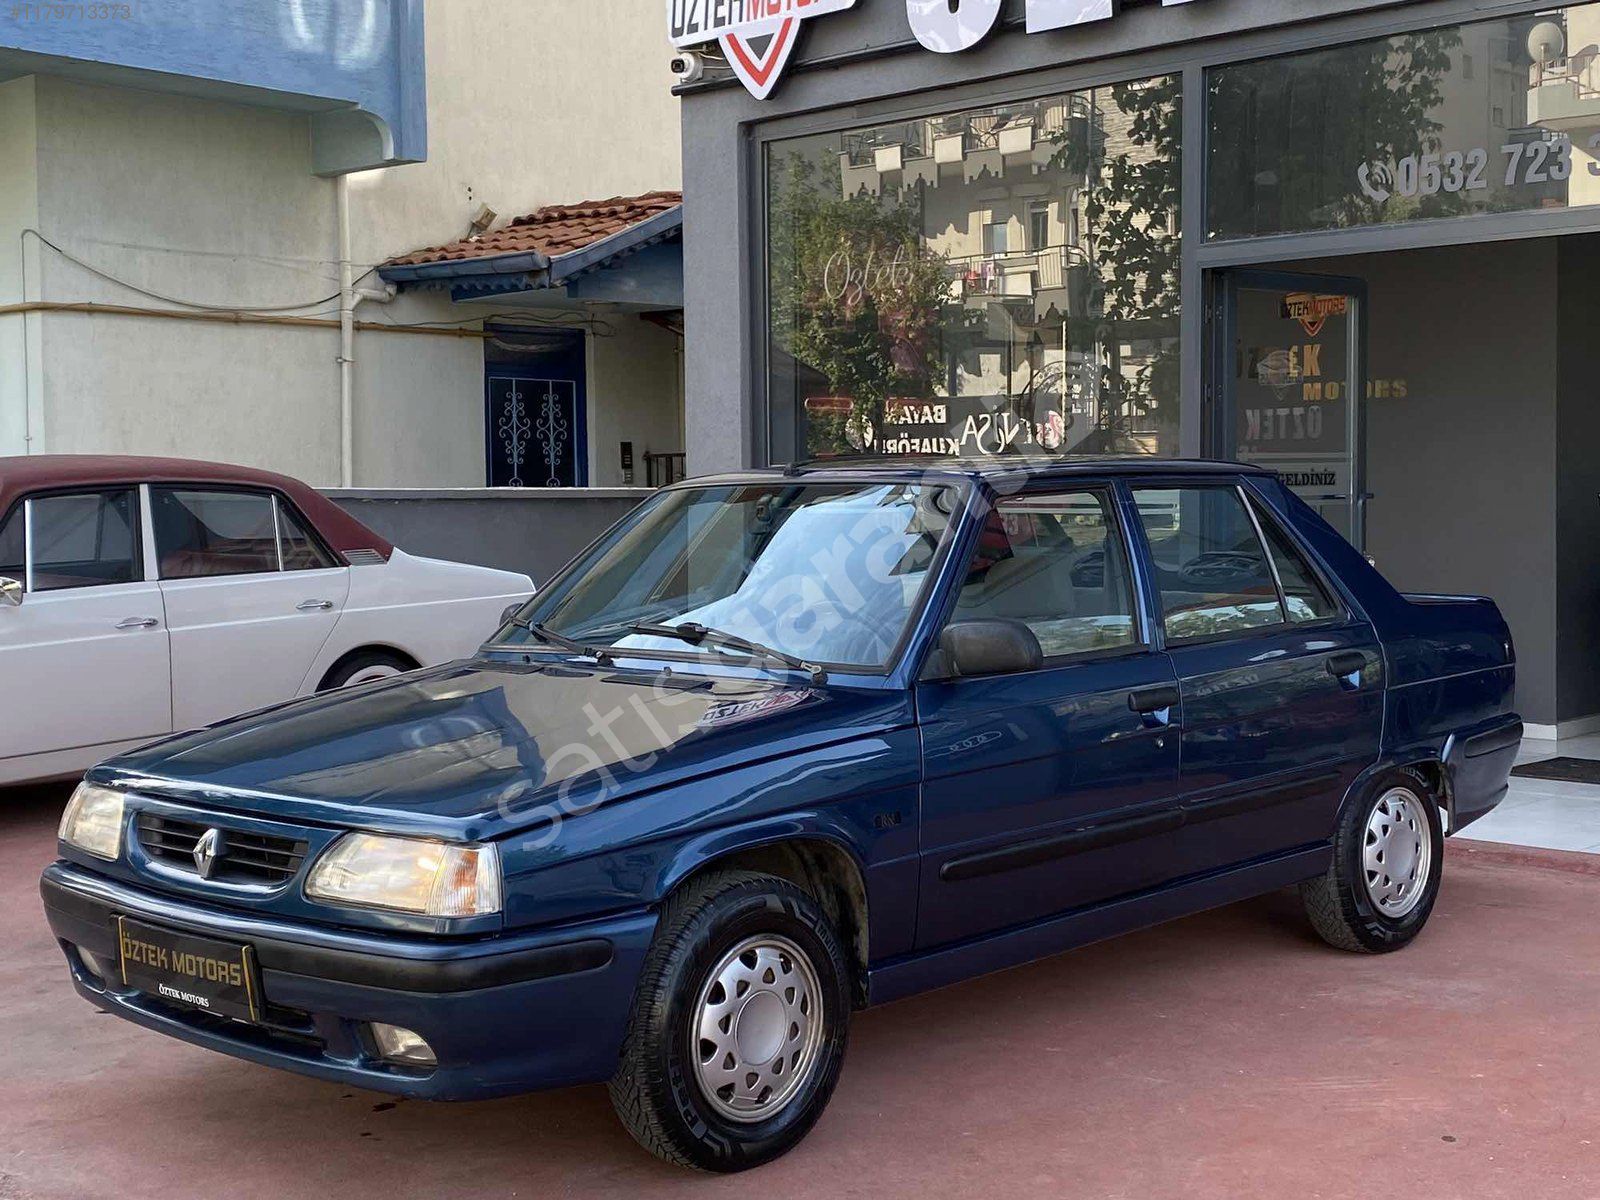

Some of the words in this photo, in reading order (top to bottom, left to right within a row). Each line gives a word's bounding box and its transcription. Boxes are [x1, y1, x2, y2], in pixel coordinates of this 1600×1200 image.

[1399, 148, 1488, 197] 0532
[1501, 138, 1573, 187] 723
[123, 931, 169, 970] ÖZTEK
[172, 951, 242, 986] MOTORS
[158, 983, 180, 999] ÖZTEK
[180, 991, 210, 1008] MOTORS
